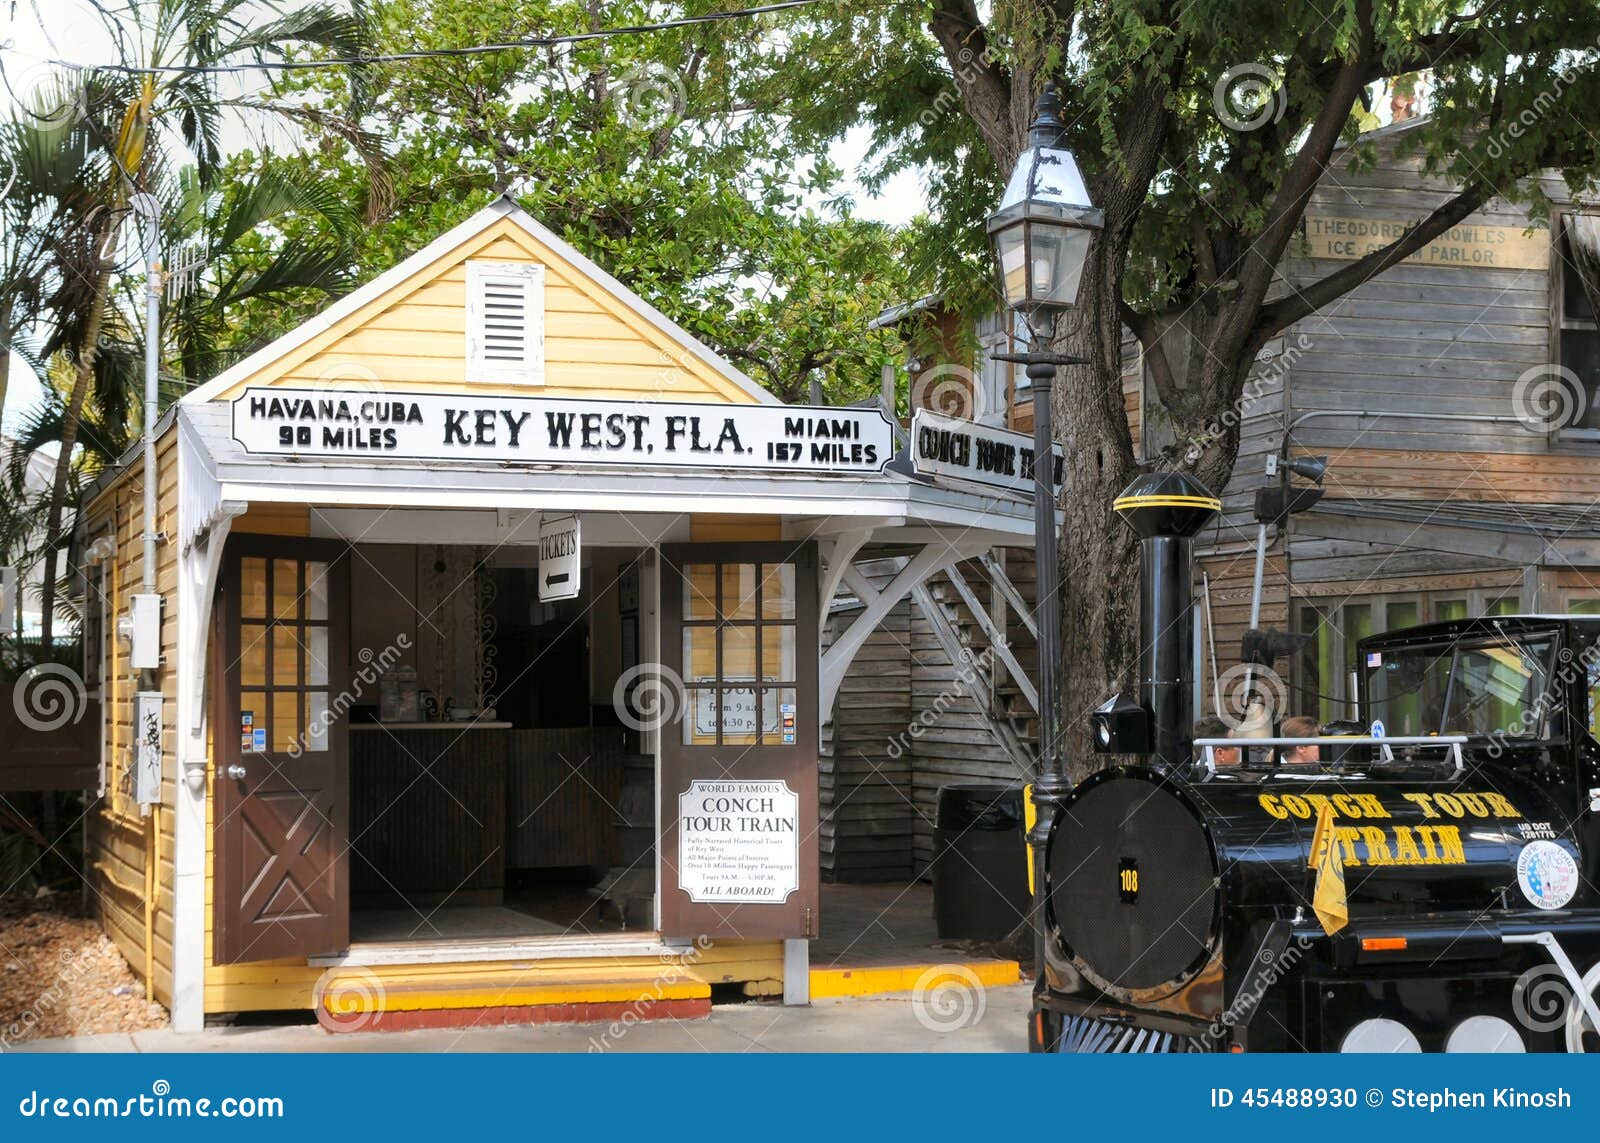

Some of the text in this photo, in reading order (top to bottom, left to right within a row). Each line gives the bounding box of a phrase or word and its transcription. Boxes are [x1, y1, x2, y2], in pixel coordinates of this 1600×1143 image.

[1313, 220, 1403, 237] THEODORE
[1328, 241, 1356, 256] ICE
[1431, 246, 1494, 264] PARLOR
[279, 426, 398, 449] 90 MILES
[443, 408, 753, 455] KEY WEST, FLA.
[784, 416, 860, 440] MIAMI
[767, 442, 878, 464] 157 MILES
[918, 425, 971, 467] CONCH
[975, 437, 1016, 477] TOUR
[540, 529, 576, 560] TICKETS
[736, 703, 742, 712] 9
[698, 784, 780, 793] WORLD FAMOUS
[702, 798, 774, 813] CONCH
[1258, 791, 1522, 820] CONCH TOUR
[683, 816, 794, 832] TOUR TRAIN
[1532, 822, 1551, 830] DOT
[1333, 824, 1467, 867] TRAIN
[701, 886, 776, 897] ALL ABOARD!
[1120, 869, 1138, 892] 108
